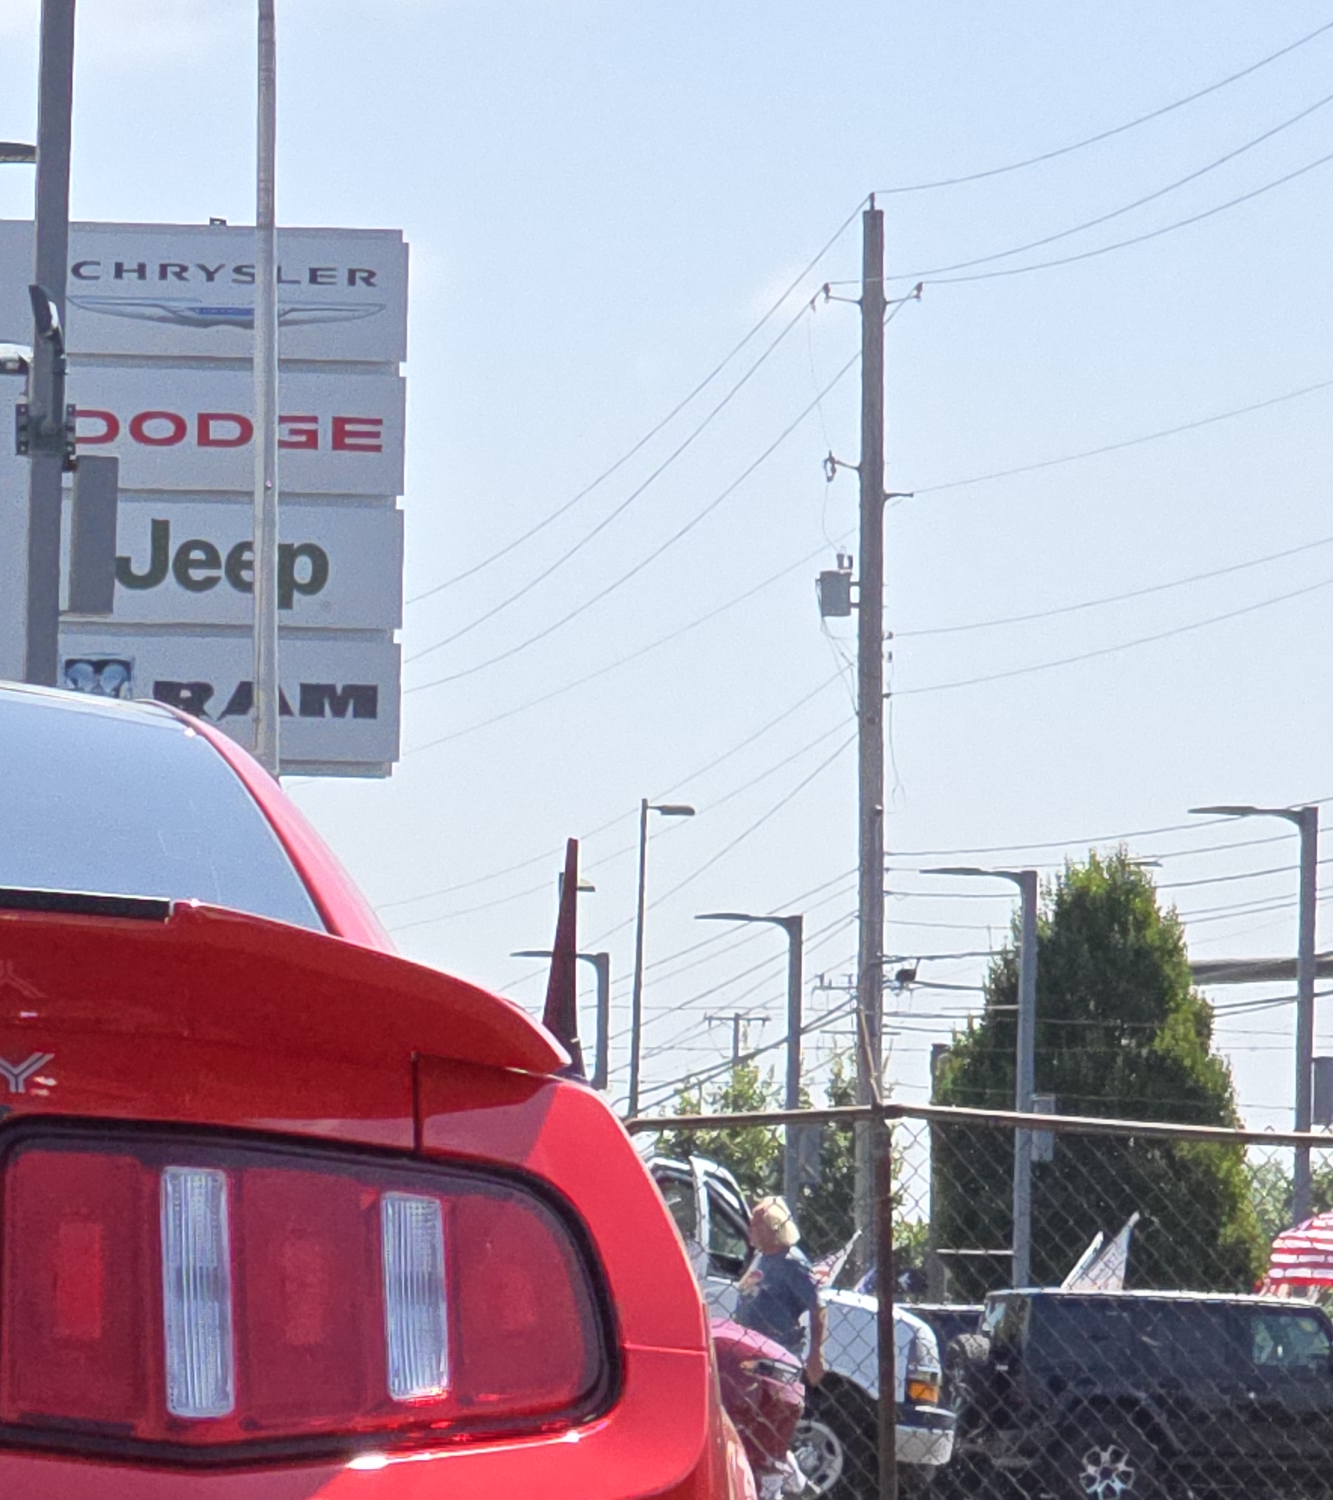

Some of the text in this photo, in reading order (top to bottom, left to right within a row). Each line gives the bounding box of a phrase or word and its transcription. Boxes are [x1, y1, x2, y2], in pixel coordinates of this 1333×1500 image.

[70, 260, 378, 288] CHRYSLER
[75, 409, 383, 452] DODGE
[114, 518, 330, 610] Jeep
[152, 680, 379, 721] RAM
